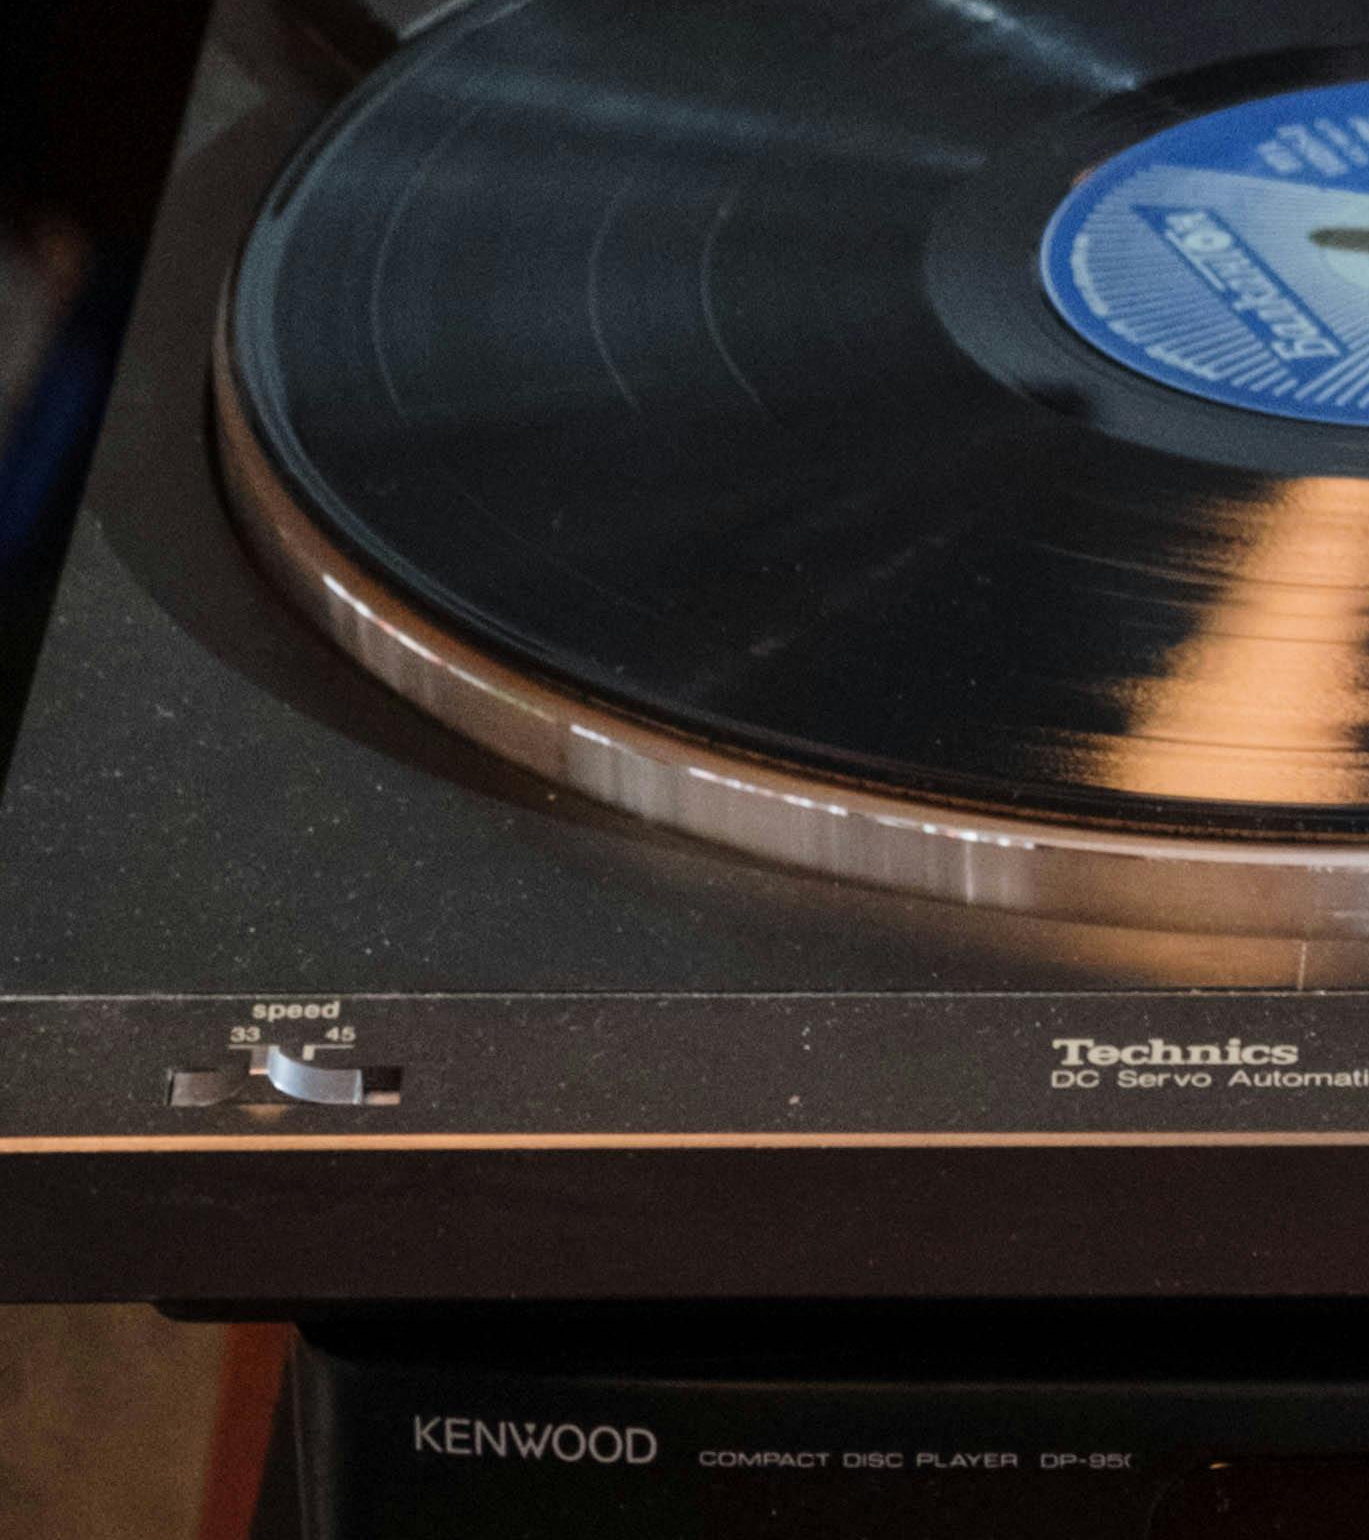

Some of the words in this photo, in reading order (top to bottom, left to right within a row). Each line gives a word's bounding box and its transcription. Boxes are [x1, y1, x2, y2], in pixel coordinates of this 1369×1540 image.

[253, 1000, 341, 1022] speed
[230, 1027, 261, 1042] 33
[325, 1027, 356, 1042] 45
[1053, 1038, 1299, 1065] Technics
[1051, 1070, 1099, 1088] DC
[1117, 1069, 1211, 1088] Servo
[413, 1416, 659, 1465] KENWOOD
[699, 1451, 829, 1469] COMPACT
[842, 1452, 904, 1469] DISC
[916, 1452, 1018, 1469] PLAYER
